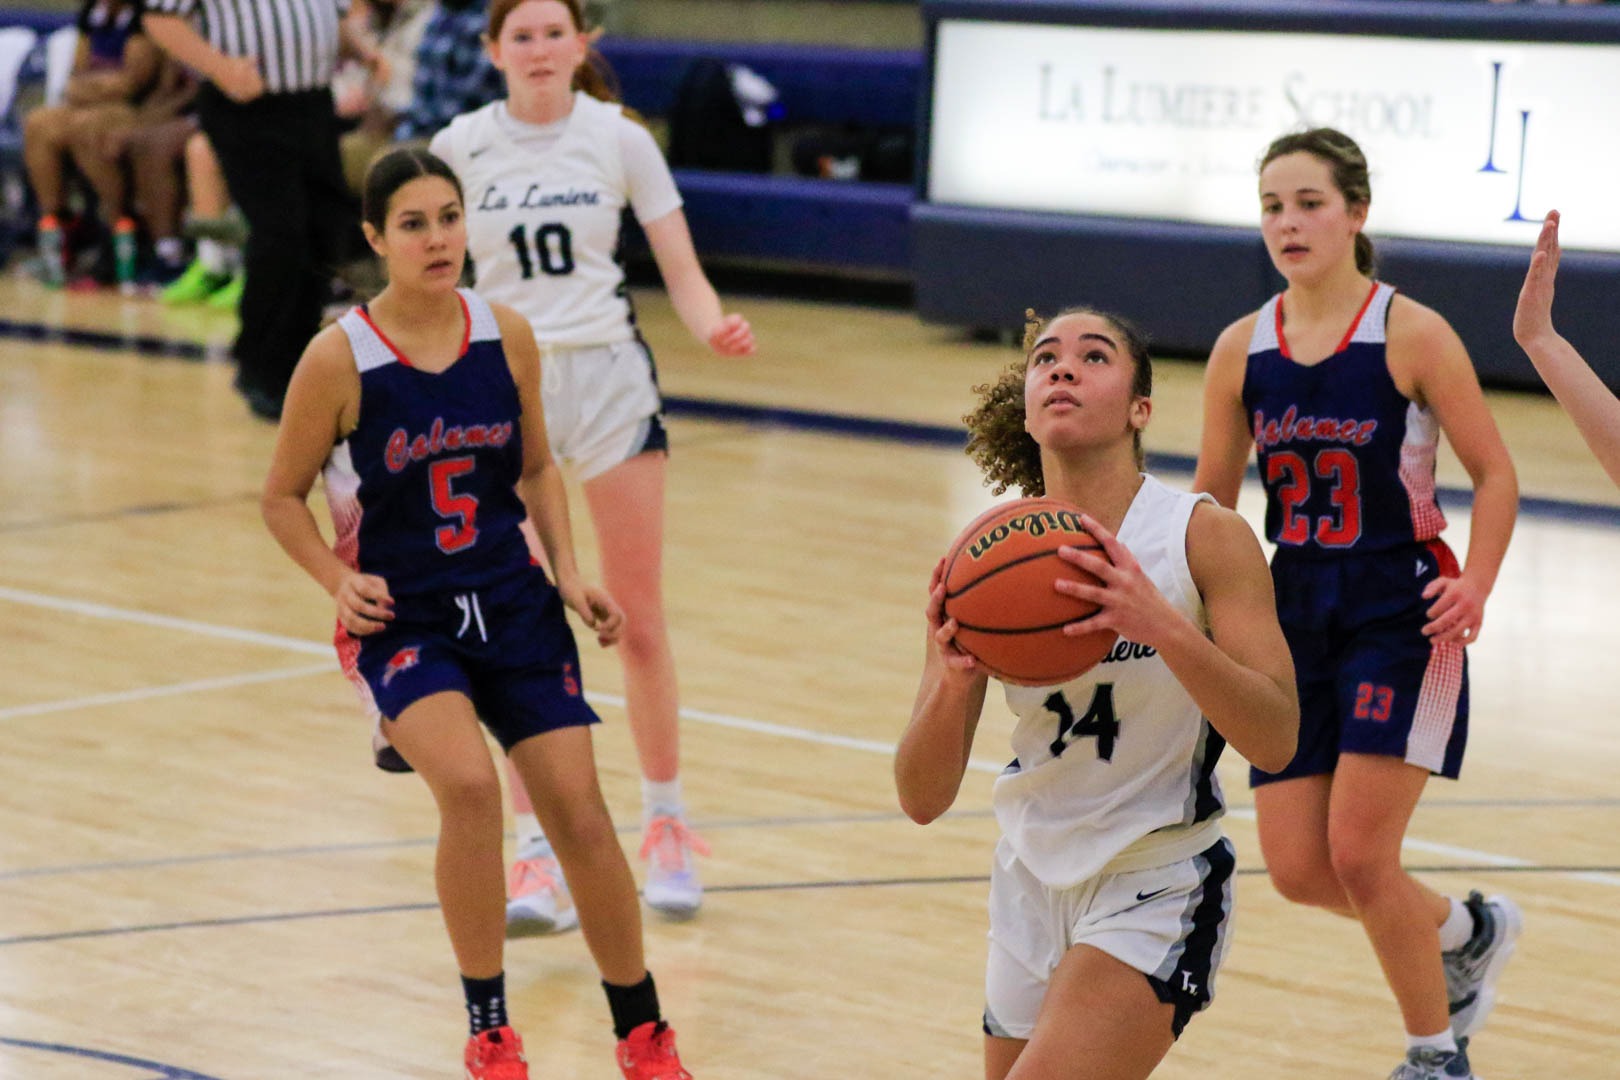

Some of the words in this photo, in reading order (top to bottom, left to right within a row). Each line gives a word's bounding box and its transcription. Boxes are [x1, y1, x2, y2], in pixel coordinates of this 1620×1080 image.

[477, 184, 507, 212] La
[508, 221, 574, 280] 10
[428, 454, 479, 555] 5
[1267, 448, 1362, 549] 23
[1042, 682, 1121, 764] 14
[1353, 681, 1395, 723] 23
